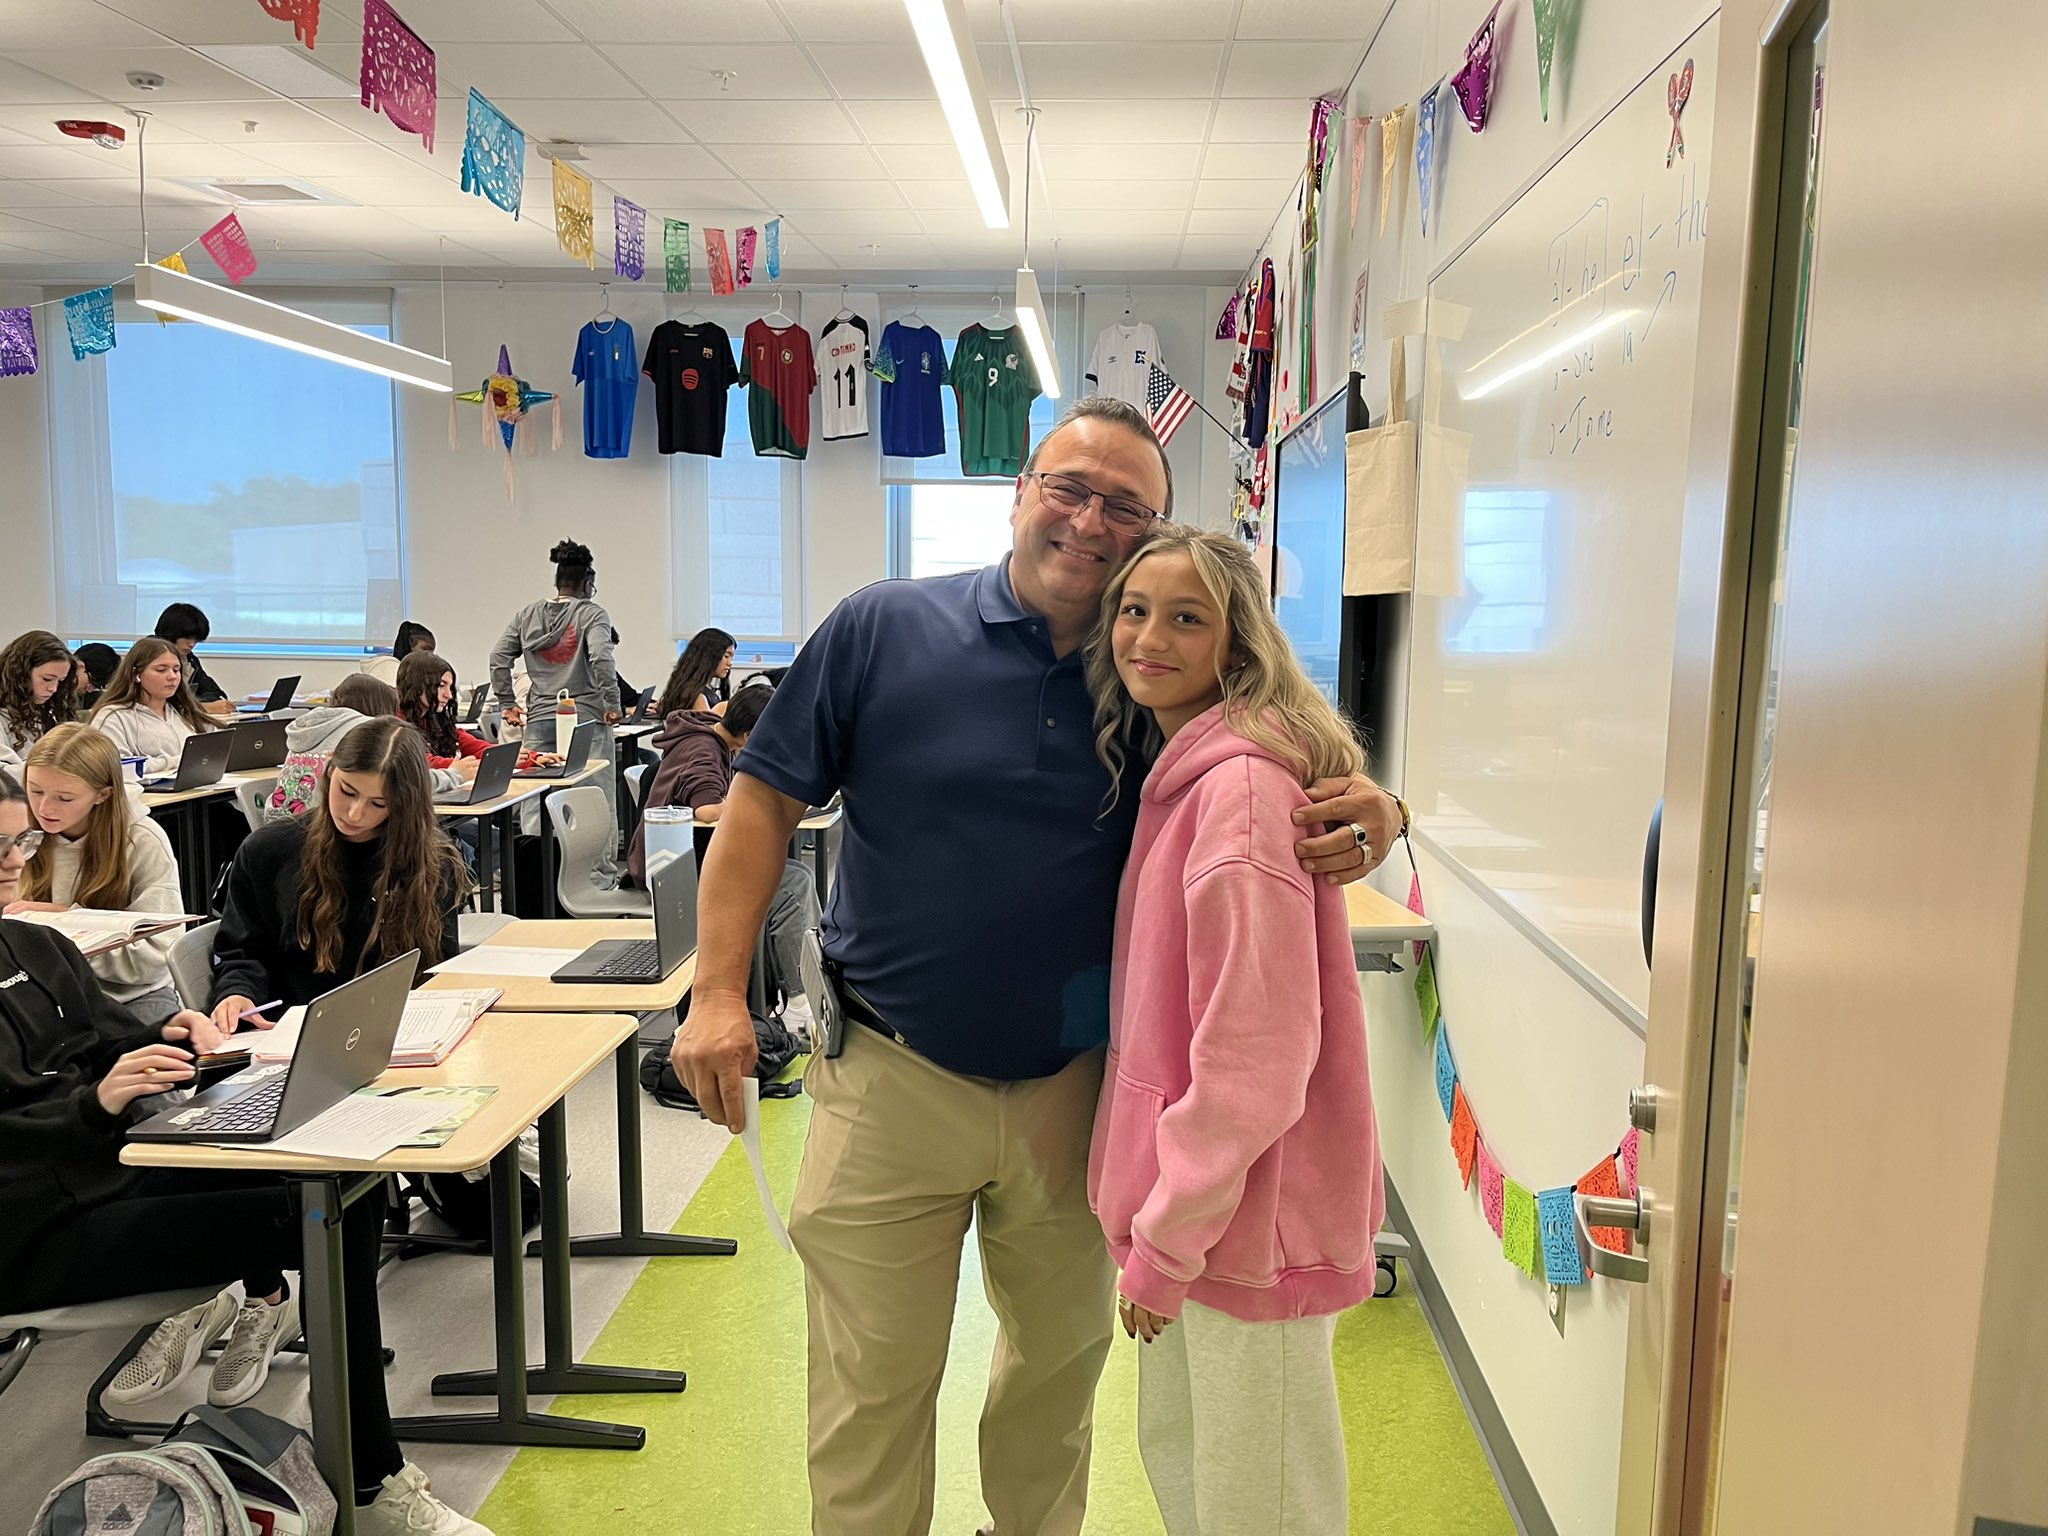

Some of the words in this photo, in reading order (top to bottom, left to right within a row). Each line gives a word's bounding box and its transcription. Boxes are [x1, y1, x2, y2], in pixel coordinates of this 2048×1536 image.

[757, 346, 765, 361] 7
[833, 363, 855, 408] 11
[987, 367, 999, 387] 9
